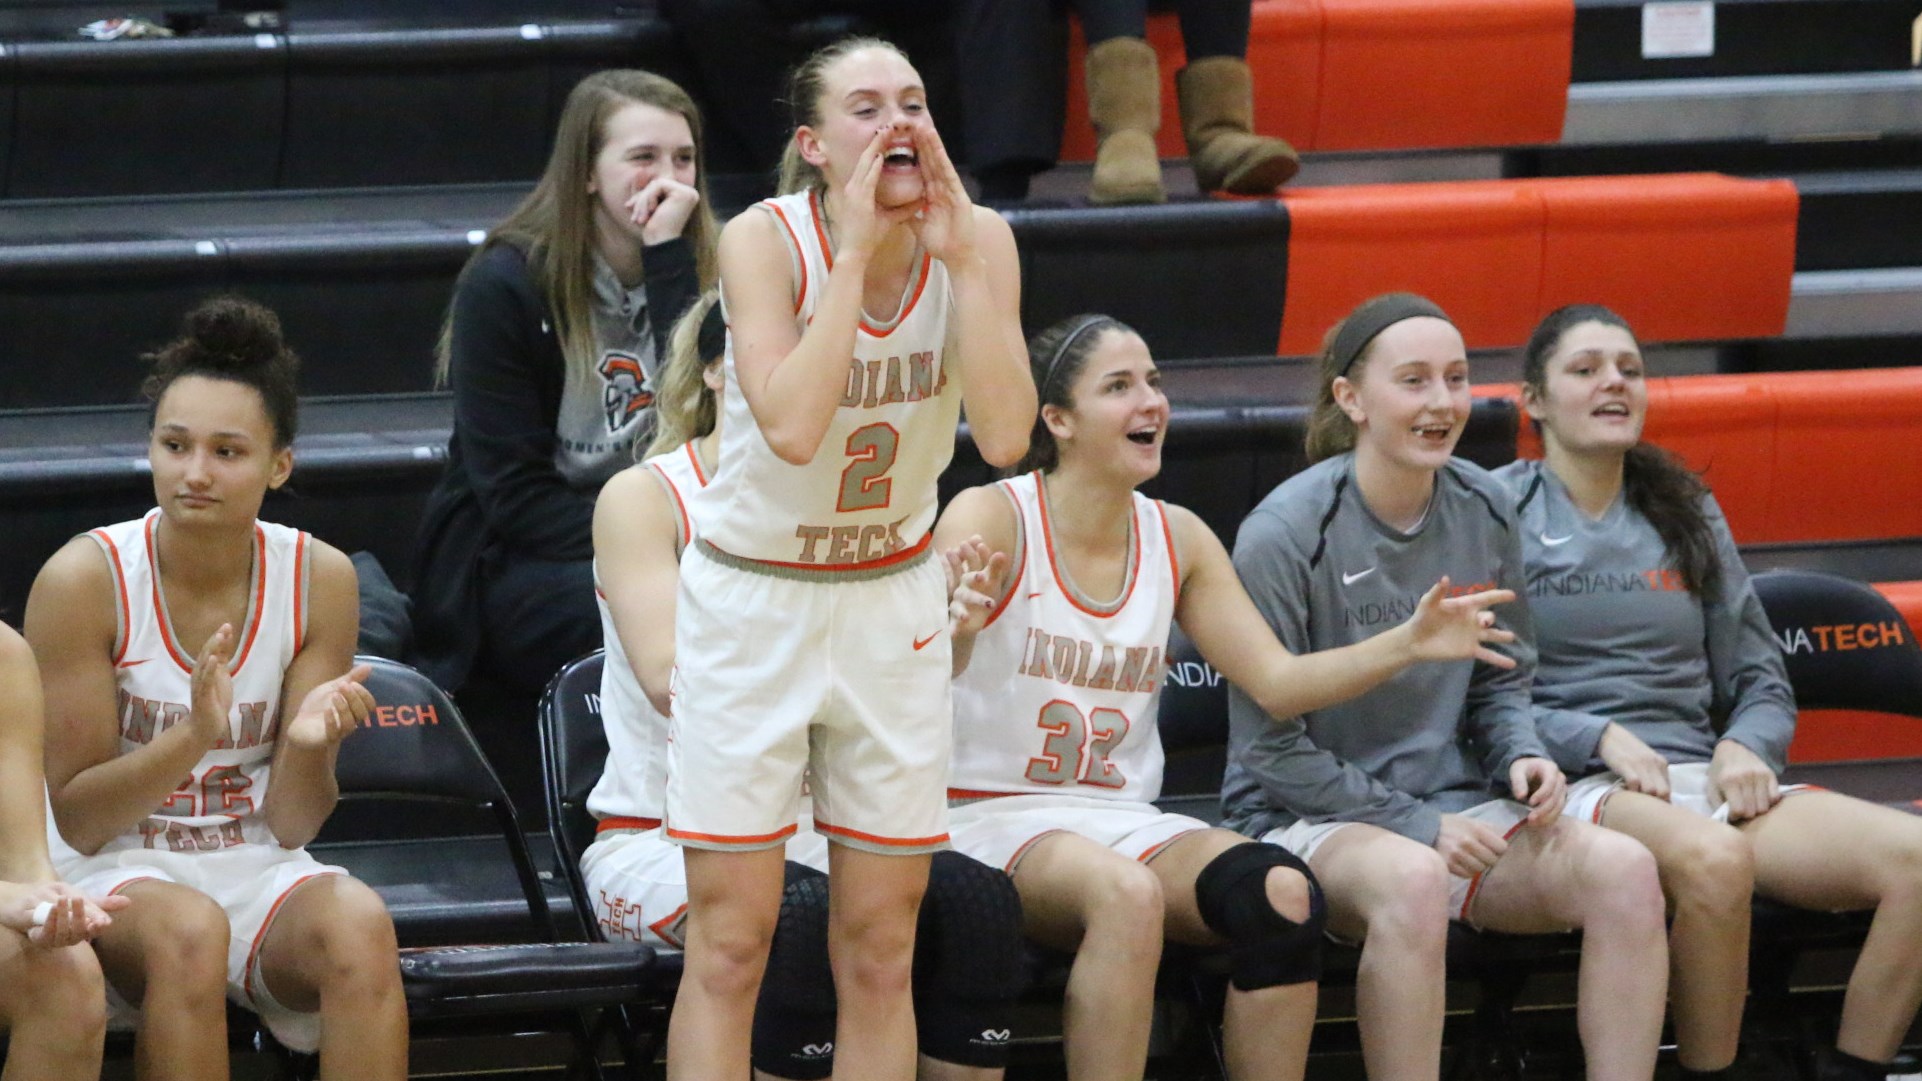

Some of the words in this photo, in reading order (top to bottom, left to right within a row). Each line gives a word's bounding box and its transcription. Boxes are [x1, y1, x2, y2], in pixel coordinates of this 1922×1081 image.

[840, 348, 947, 409] DIAN
[836, 421, 900, 513] 2
[1345, 596, 1418, 626] INDIAN
[1811, 621, 1904, 652] TECH
[1024, 699, 1130, 789] 32
